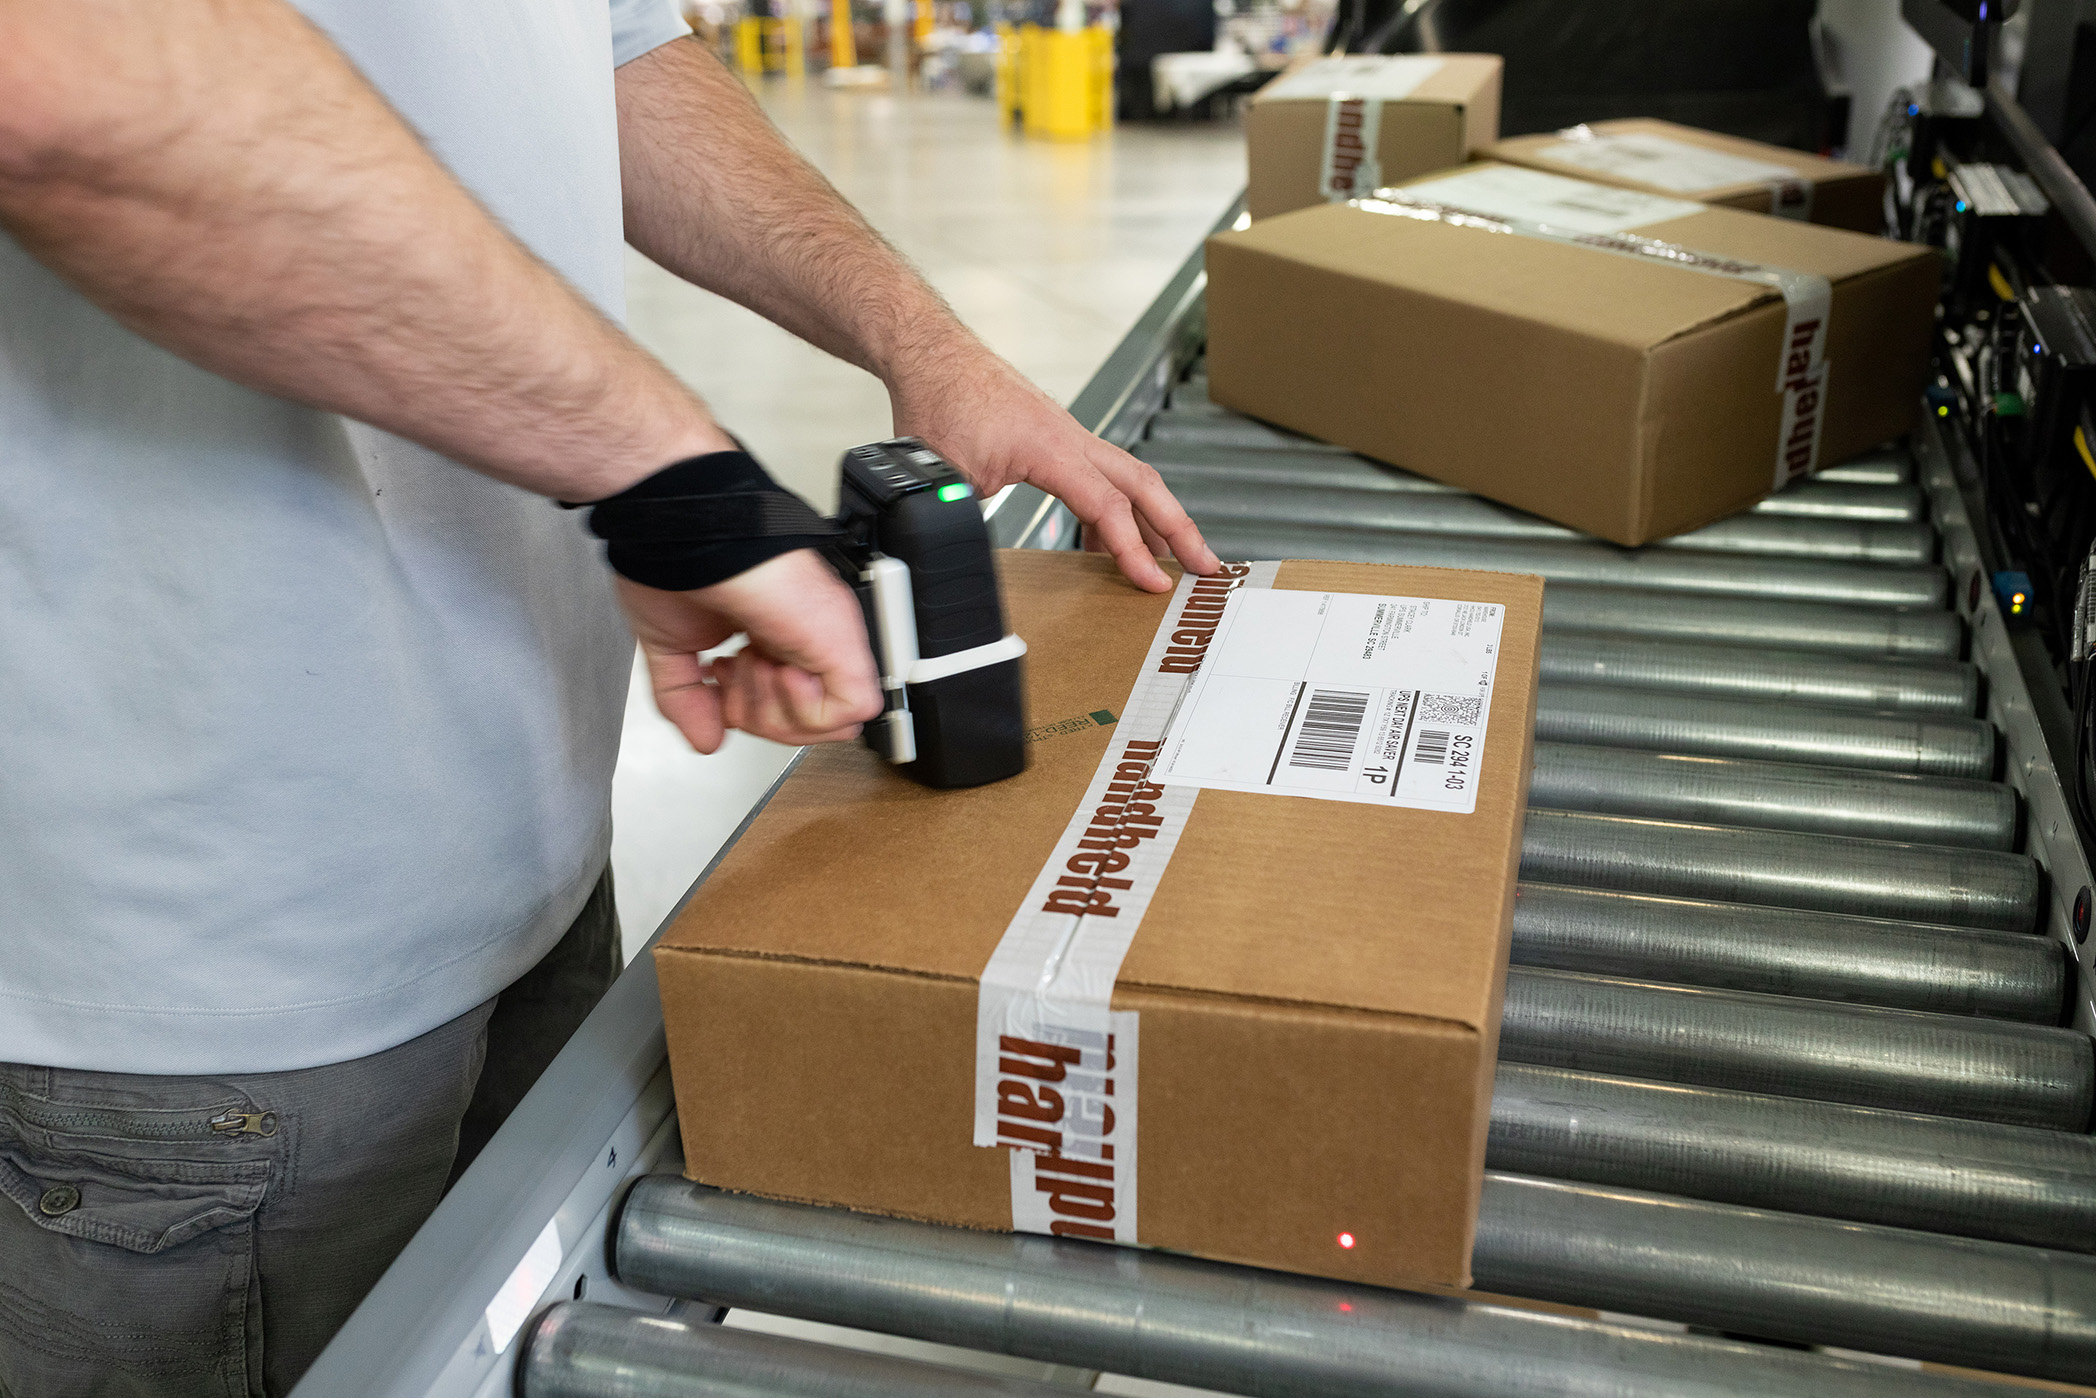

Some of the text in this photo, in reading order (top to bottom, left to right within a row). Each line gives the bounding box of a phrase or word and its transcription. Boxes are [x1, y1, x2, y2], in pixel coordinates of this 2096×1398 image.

[1369, 604, 1386, 636] SUMMERVILLE
[1378, 636, 1388, 651] STREET
[1386, 690, 1397, 707] TRACKING
[1383, 691, 1411, 760] UPS NEXT DAY AIR SAVER
[1445, 735, 1473, 789] SC 294 1-03
[1363, 766, 1388, 784] 1P
